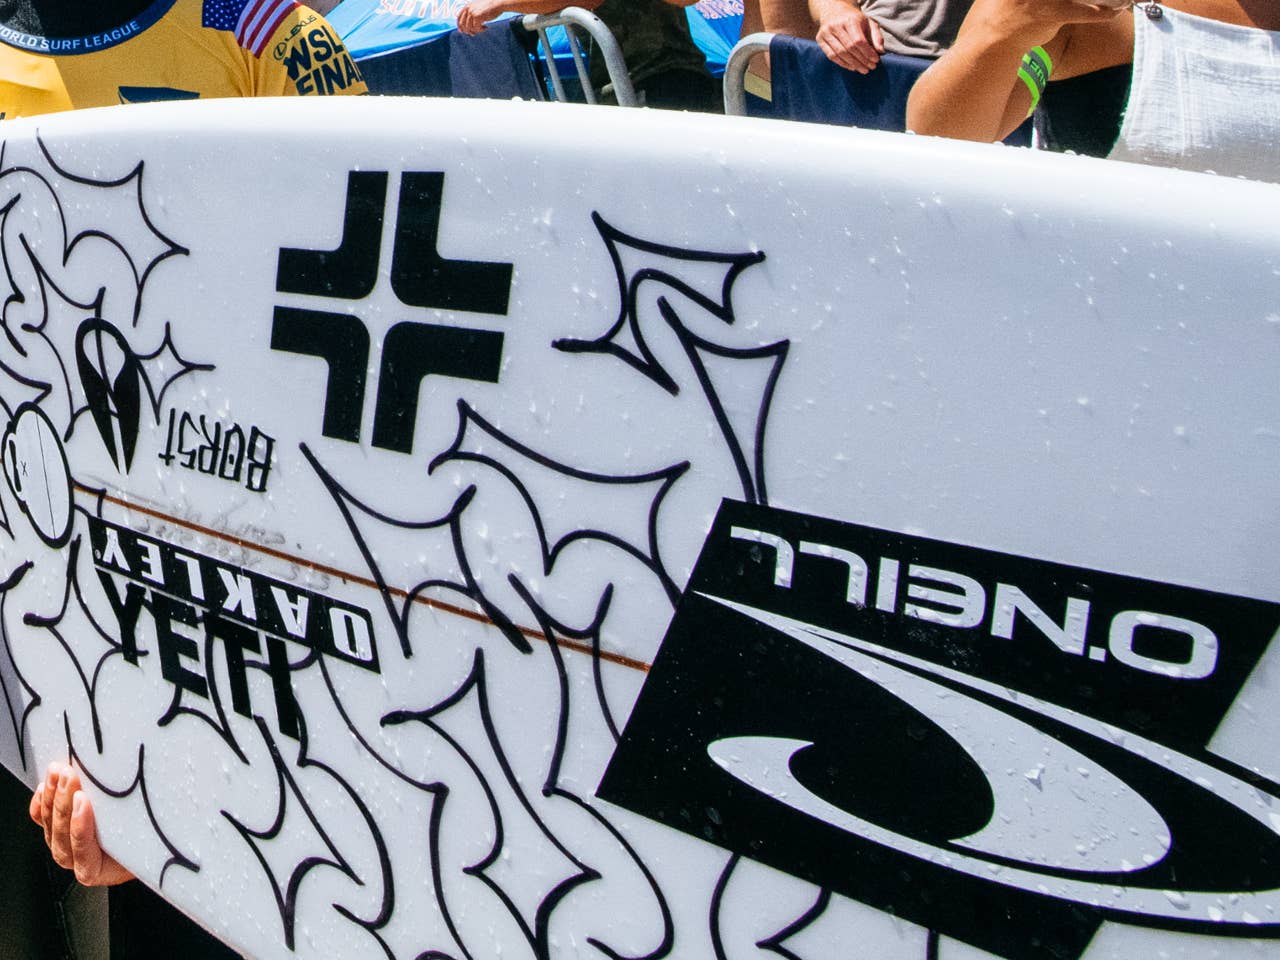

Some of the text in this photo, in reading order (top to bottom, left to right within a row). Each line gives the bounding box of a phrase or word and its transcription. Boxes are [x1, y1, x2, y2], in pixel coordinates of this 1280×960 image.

[40, 40, 82, 50] SURF
[84, 21, 141, 48] LEAGUE
[283, 25, 344, 81] WSL
[158, 407, 276, 492] BORST
[102, 527, 374, 662] OAKLEY
[730, 526, 1220, 680] O'NEILL
[95, 566, 301, 742] YETI
